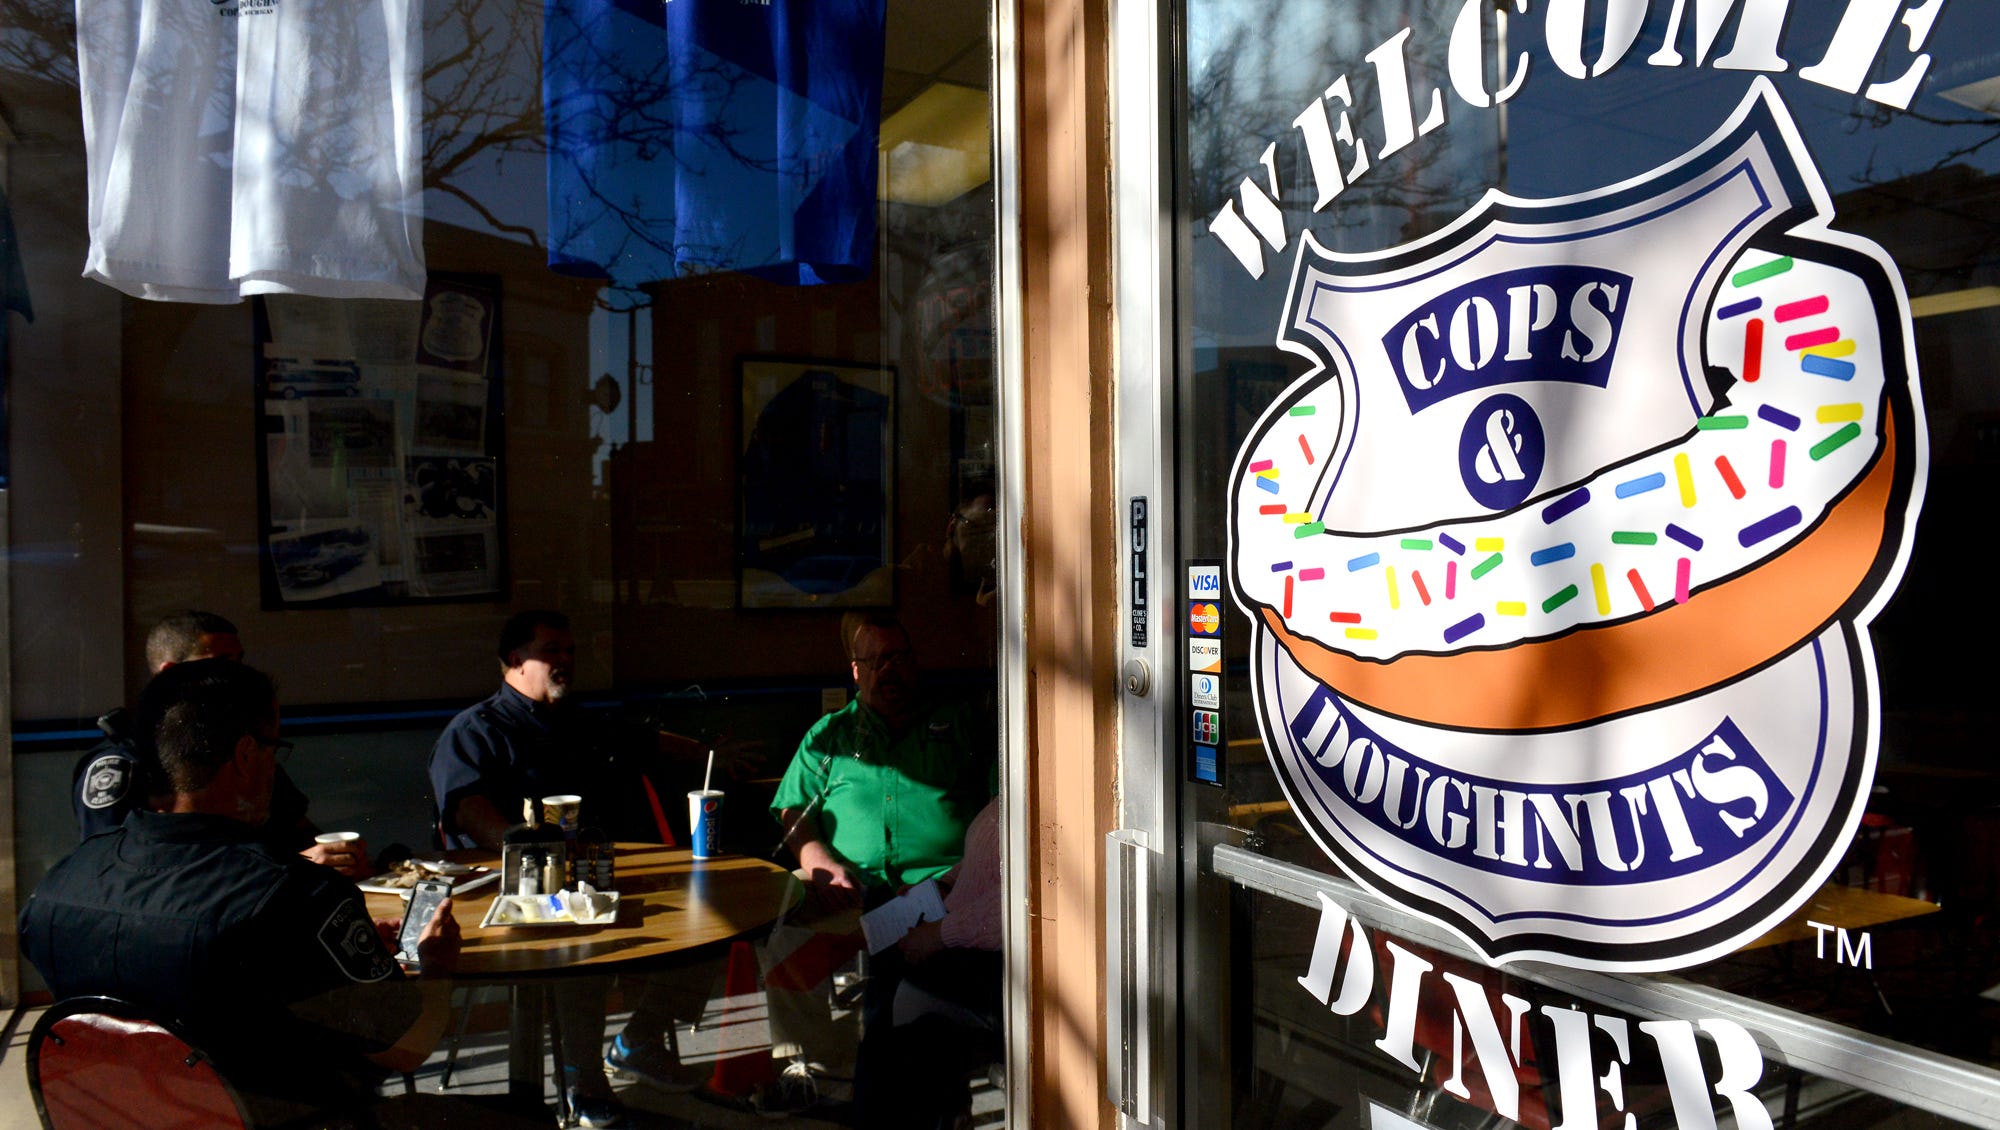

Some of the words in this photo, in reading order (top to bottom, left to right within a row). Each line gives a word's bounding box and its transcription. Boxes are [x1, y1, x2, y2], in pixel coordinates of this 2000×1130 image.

[1209, 0, 1944, 281] WELCOME
[1402, 281, 1620, 390] COPS
[1475, 409, 1525, 484] &
[1132, 501, 1145, 605] PULL
[1191, 574, 1219, 591] VISA
[1191, 613, 1219, 623] MasterCard
[1191, 645, 1219, 656] DISCOVER
[1195, 722, 1217, 734] JCB
[1302, 697, 1769, 871] DOUGHNUTS
[705, 818, 716, 850] pepsi
[1807, 919, 1874, 970] TM
[1297, 890, 1776, 1130] DINER
